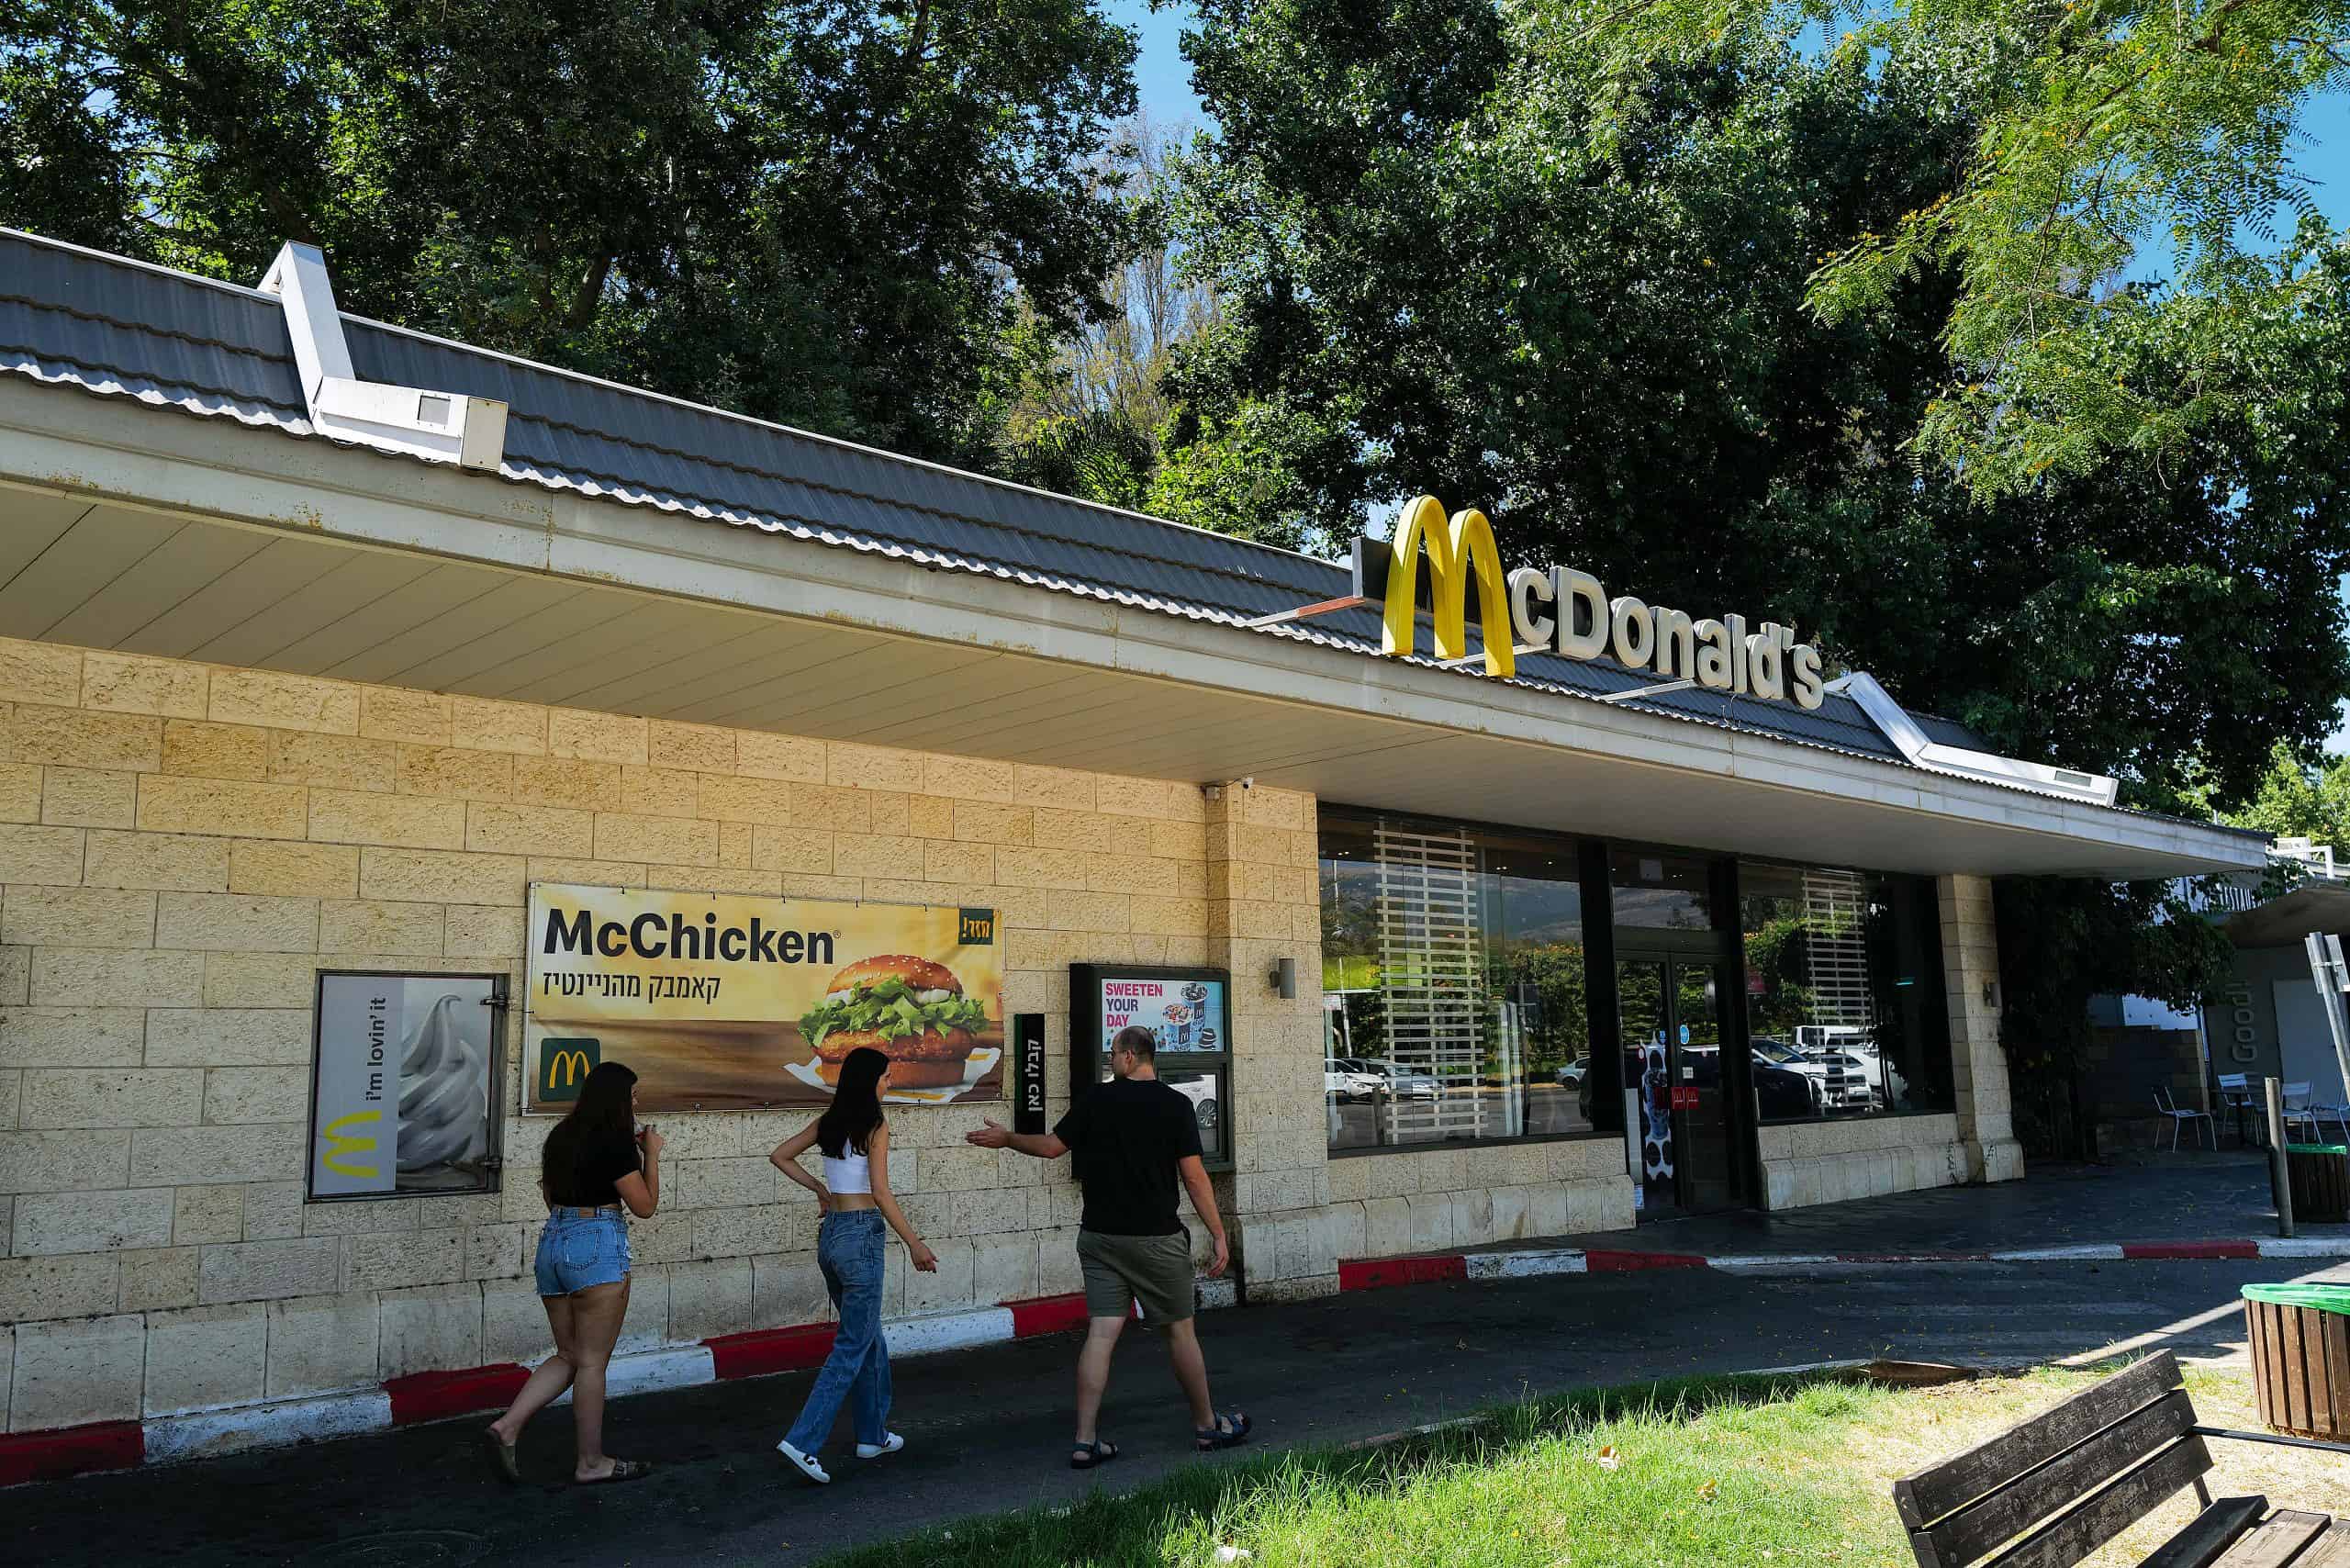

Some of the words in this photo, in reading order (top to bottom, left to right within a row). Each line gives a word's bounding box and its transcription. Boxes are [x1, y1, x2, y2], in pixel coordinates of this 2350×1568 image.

[1382, 494, 1824, 711] McDonald's
[543, 971, 641, 998] מהניינטיז
[648, 975, 722, 1004] קאמבק
[1105, 982, 1163, 997] SWEETEN
[370, 997, 386, 1010] it
[1105, 998, 1139, 1012] YOUR
[1106, 1014, 1131, 1028] DAY
[366, 1014, 386, 1067] lovin'
[1024, 1038, 1042, 1079] קבלו
[365, 1072, 383, 1101] i'm
[1027, 1083, 1044, 1112] כאן
